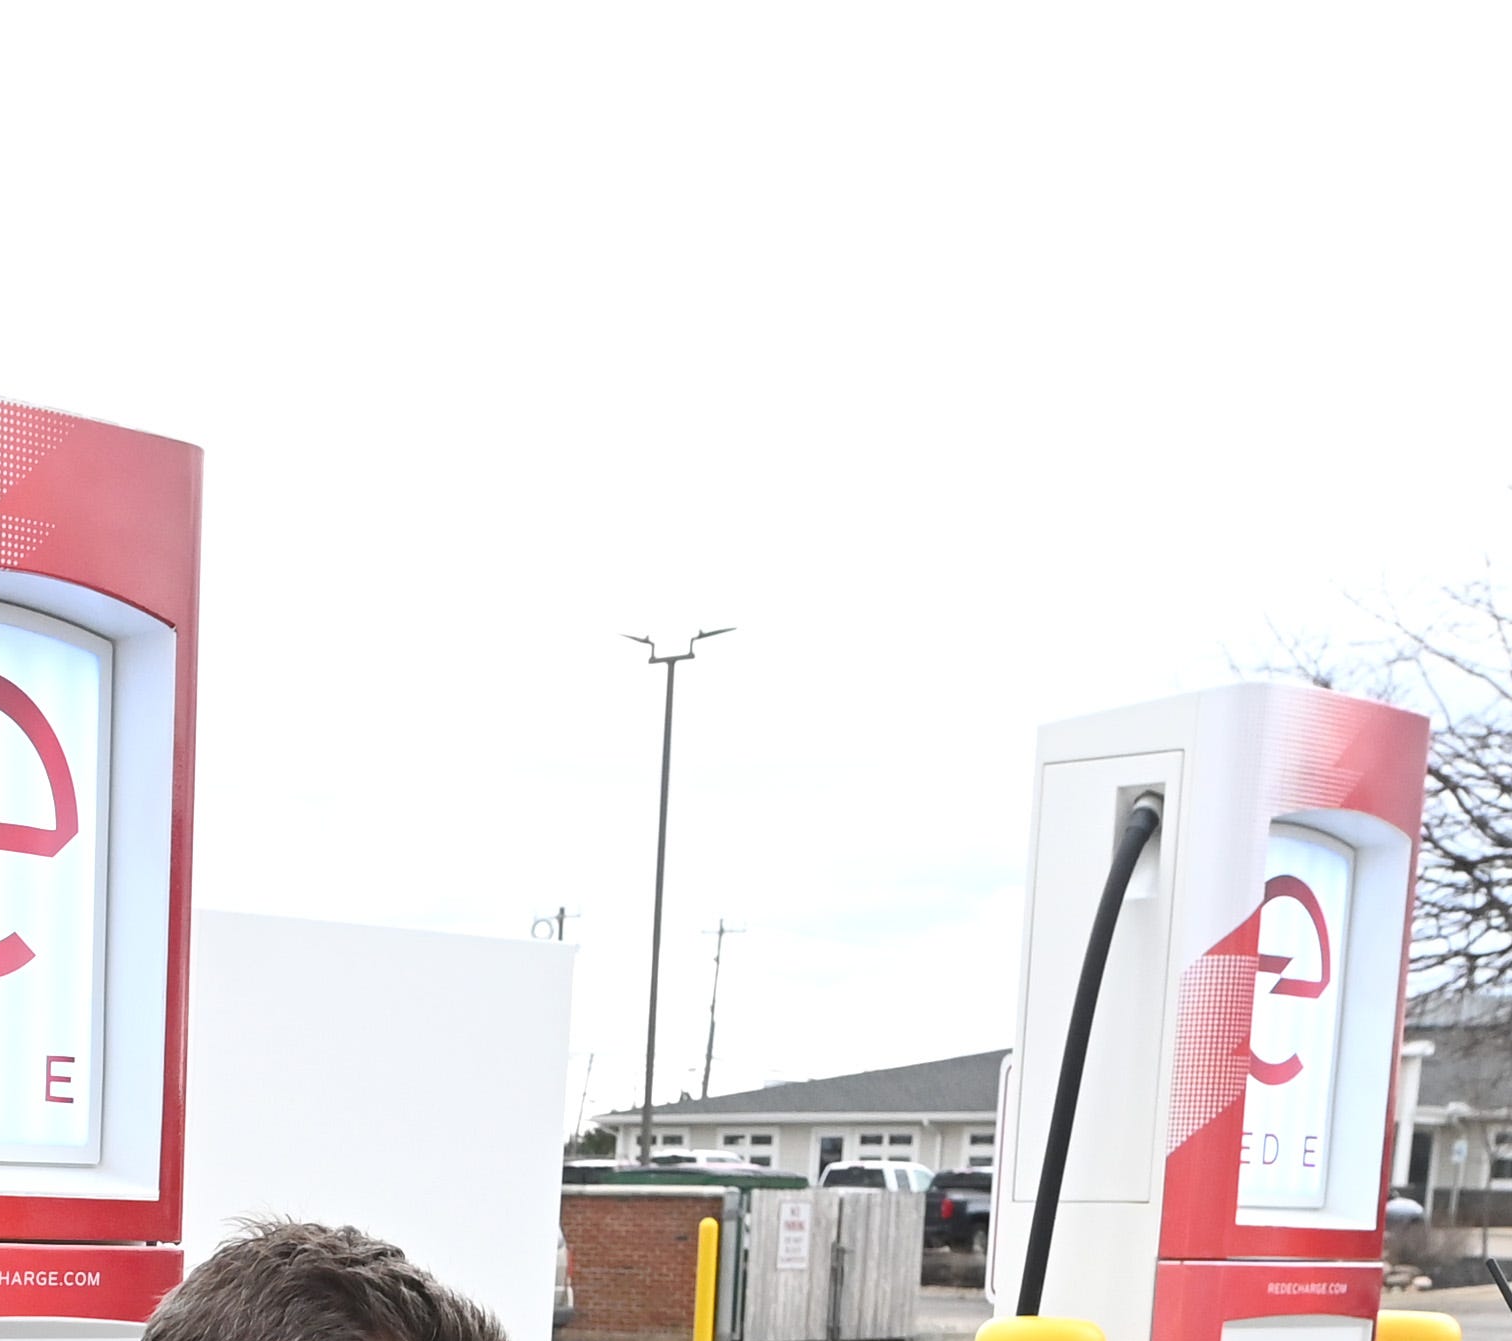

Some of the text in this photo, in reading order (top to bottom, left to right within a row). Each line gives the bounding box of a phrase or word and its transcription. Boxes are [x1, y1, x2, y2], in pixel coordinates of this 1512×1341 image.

[45, 1055, 76, 1104] E
[1239, 1131, 1280, 1166] ED
[1267, 1282, 1348, 1295] REDECHARGE.COM
